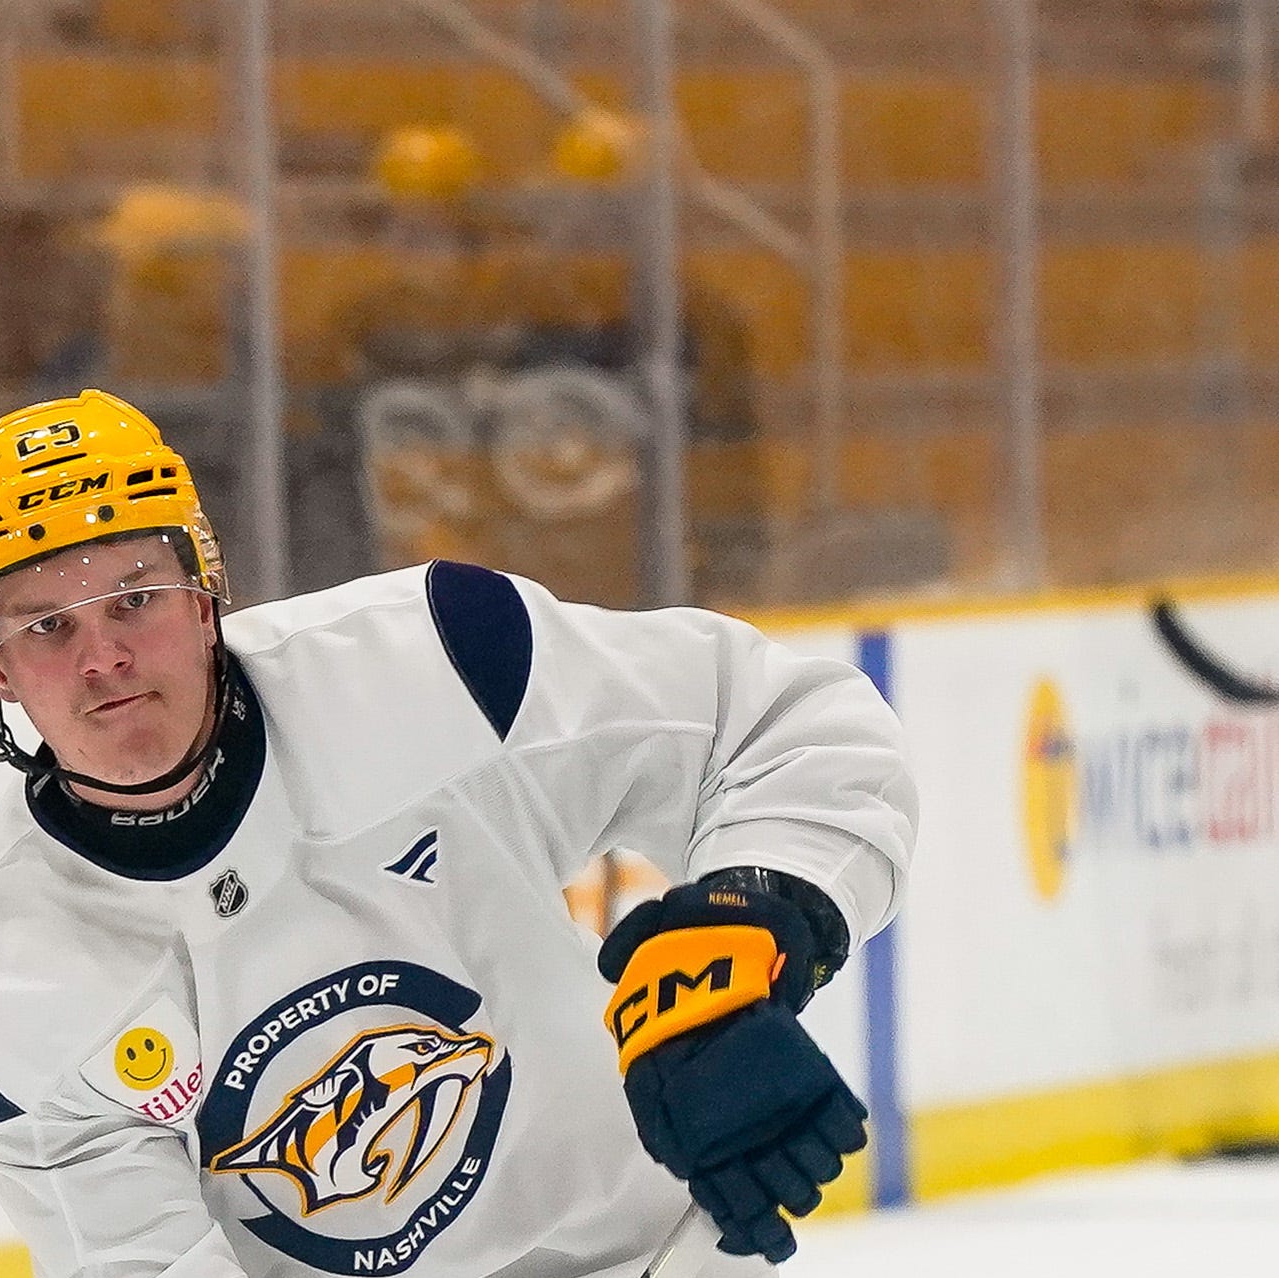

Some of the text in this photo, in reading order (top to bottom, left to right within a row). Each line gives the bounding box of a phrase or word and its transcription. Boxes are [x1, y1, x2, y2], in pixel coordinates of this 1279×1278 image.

[17, 472, 110, 511] CCM
[224, 973, 400, 1091] PROPERTY OF
[610, 954, 734, 1050] CM
[353, 1156, 481, 1274] NASHVILLE
